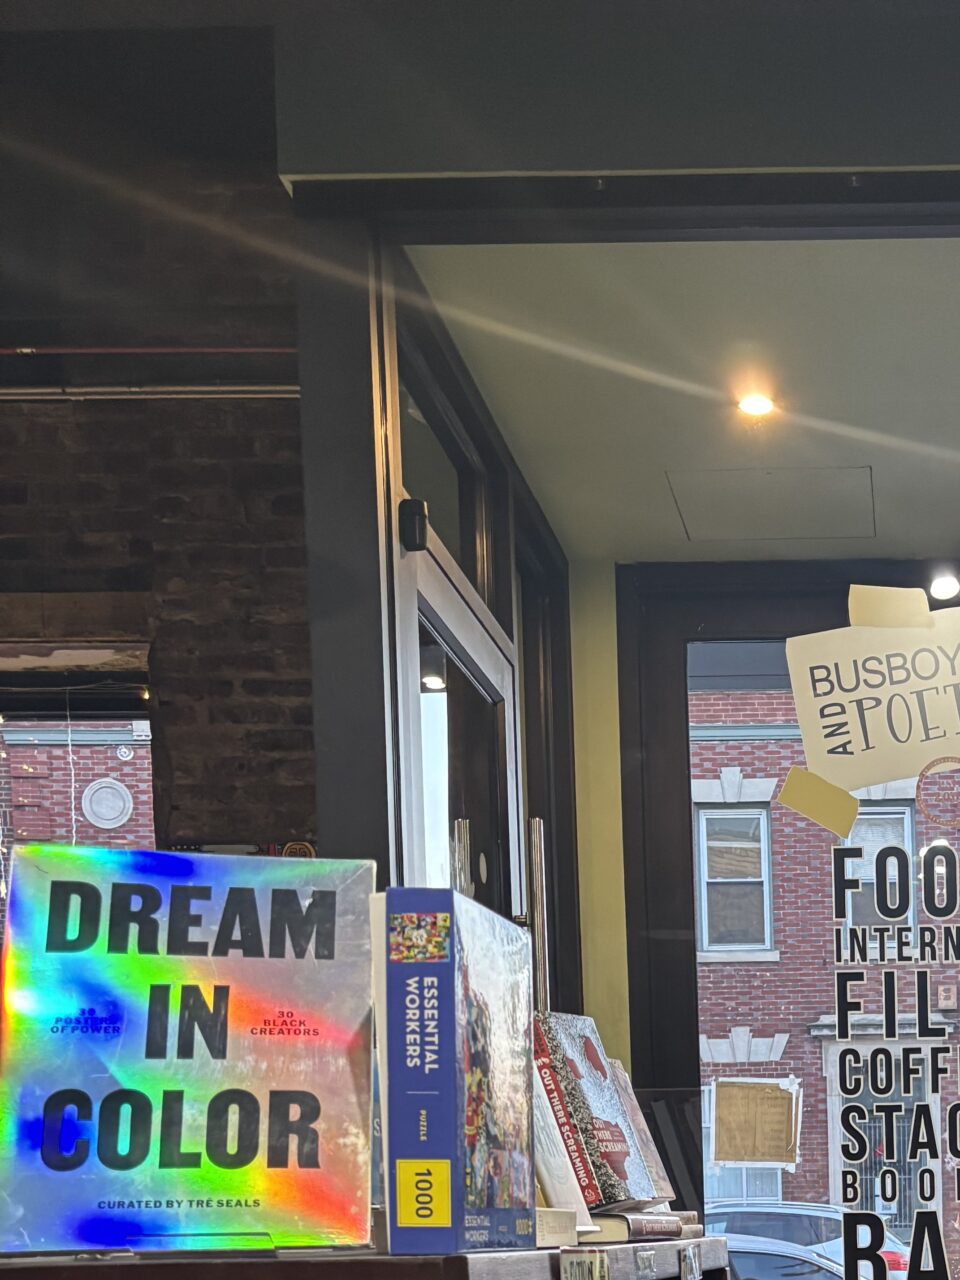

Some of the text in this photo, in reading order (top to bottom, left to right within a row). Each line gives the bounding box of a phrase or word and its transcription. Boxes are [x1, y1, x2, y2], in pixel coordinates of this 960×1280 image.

[819, 702, 855, 756] AND
[45, 880, 337, 960] DREAM
[55, 1017, 120, 1027] POSTERS
[79, 1008, 97, 1017] 30
[145, 984, 230, 1059] IN
[263, 1019, 306, 1028] BLACK
[277, 1011, 294, 1019] 30
[405, 976, 420, 1068] WORKERS
[50, 1025, 121, 1034] OF POWER
[250, 1028, 320, 1036] CREATORS
[423, 976, 439, 1074] ESSENTIAL
[40, 1088, 321, 1172] COLOR
[419, 1109, 427, 1142] PUZZLE
[541, 1068, 589, 1187] OUT THERE SCREAMING
[594, 1129, 612, 1143] THERE
[599, 1141, 629, 1153] SCREAMING
[98, 1200, 162, 1210] CURATED
[165, 1200, 184, 1209] BY
[216, 1199, 261, 1208] SEALS
[414, 1168, 433, 1219] 1000
